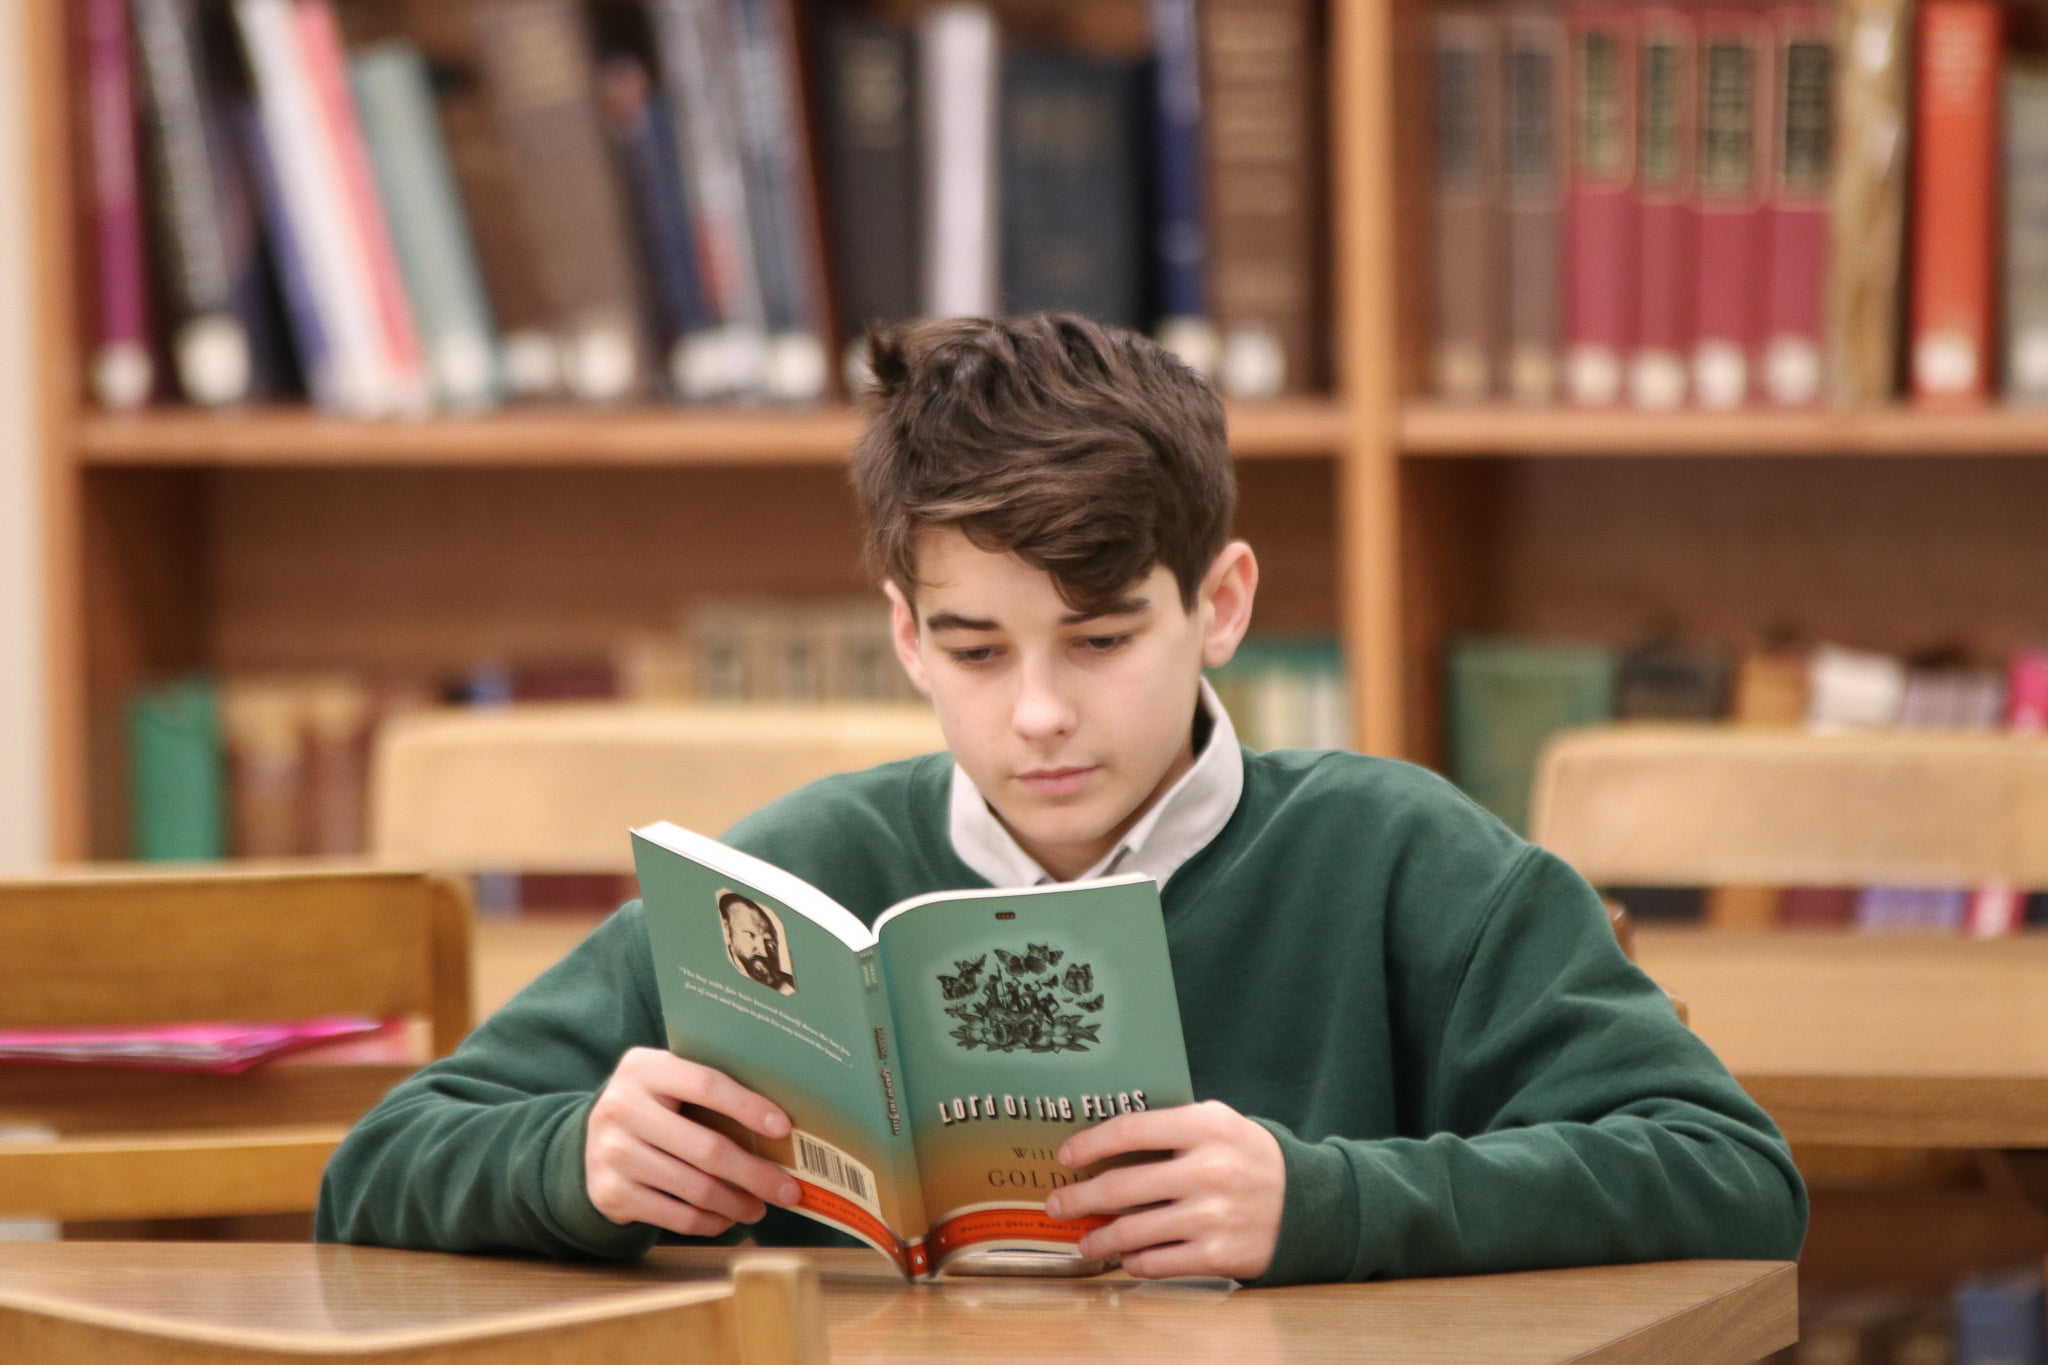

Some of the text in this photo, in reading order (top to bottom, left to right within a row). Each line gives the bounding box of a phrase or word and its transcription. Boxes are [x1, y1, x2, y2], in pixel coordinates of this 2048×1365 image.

[939, 1094, 998, 1125] Lord
[1036, 1095, 1073, 1121] the
[1012, 1147, 1055, 1161] Will
